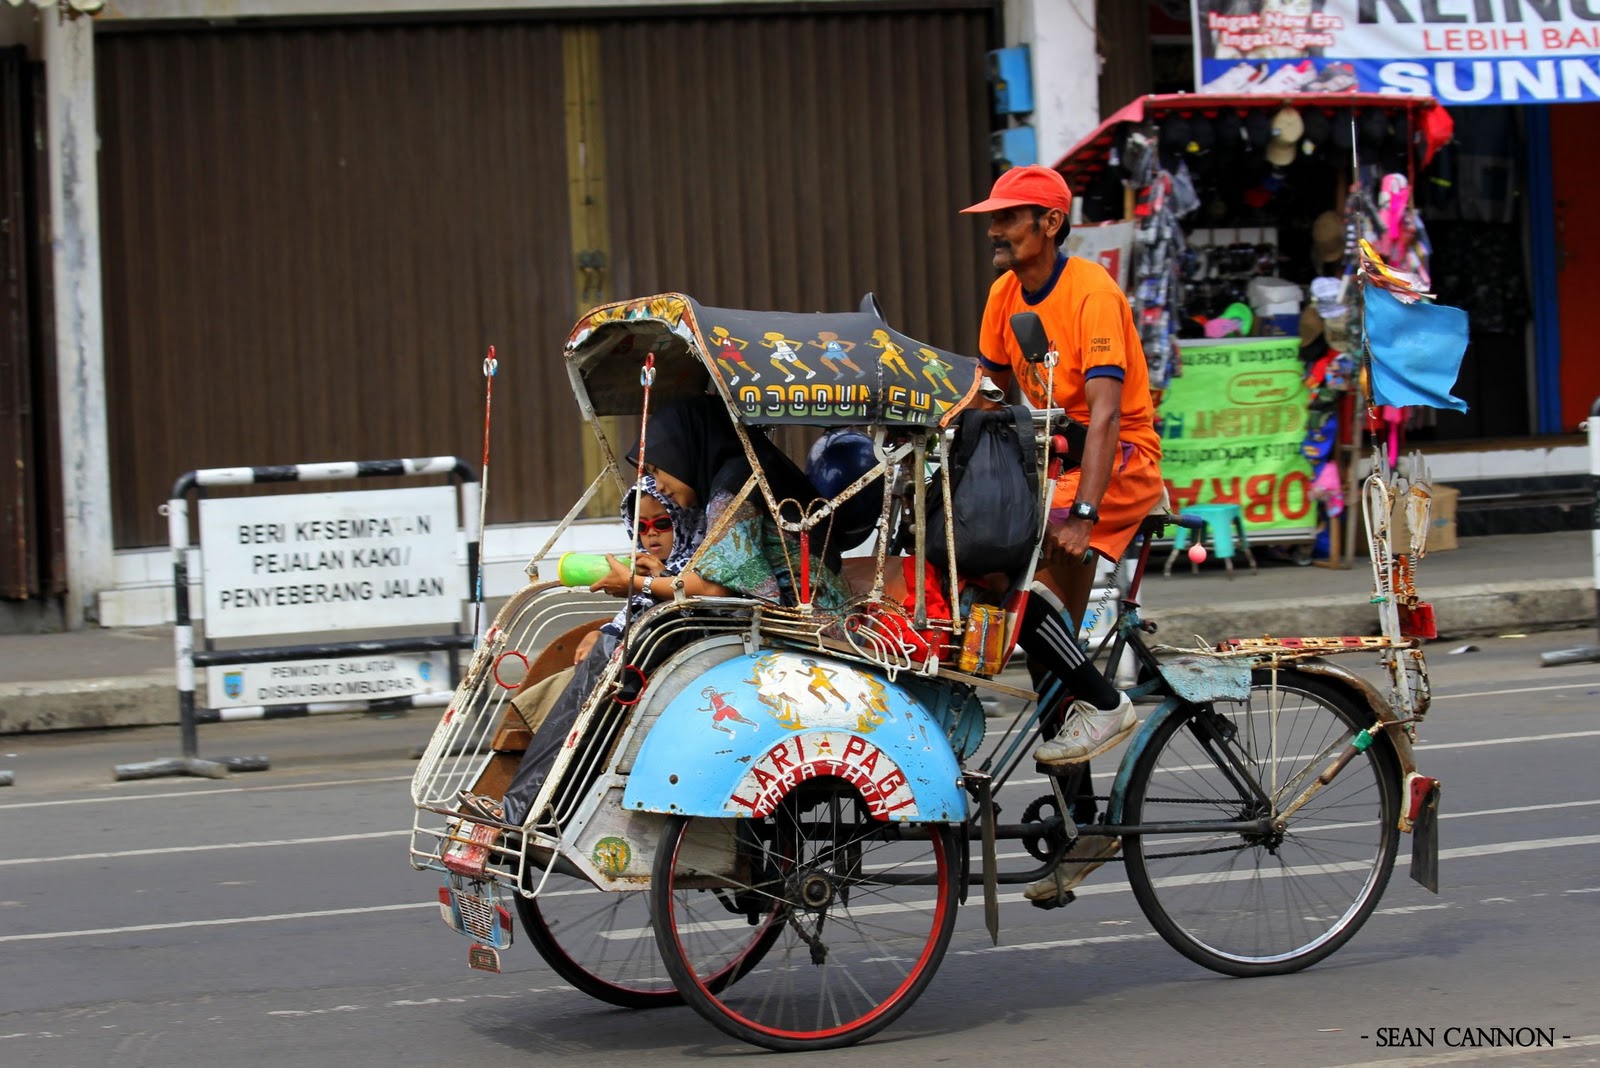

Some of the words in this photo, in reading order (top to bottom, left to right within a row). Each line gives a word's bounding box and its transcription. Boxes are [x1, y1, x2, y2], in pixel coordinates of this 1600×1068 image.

[1208, 11, 1261, 33] Ingat
[1264, 13, 1309, 29] New
[1311, 11, 1343, 29] Era
[1220, 30, 1272, 50] Ingat
[1275, 29, 1335, 50] Agnes
[1423, 28, 1527, 51] LEBIH
[1378, 59, 1600, 101] SUNN
[238, 523, 285, 545] BERI
[253, 549, 344, 574] PEJALAN
[220, 580, 373, 610] PENYEBERANG
[380, 577, 444, 600] JALAN
[730, 735, 805, 811] LARI
[843, 735, 916, 812] PAGI
